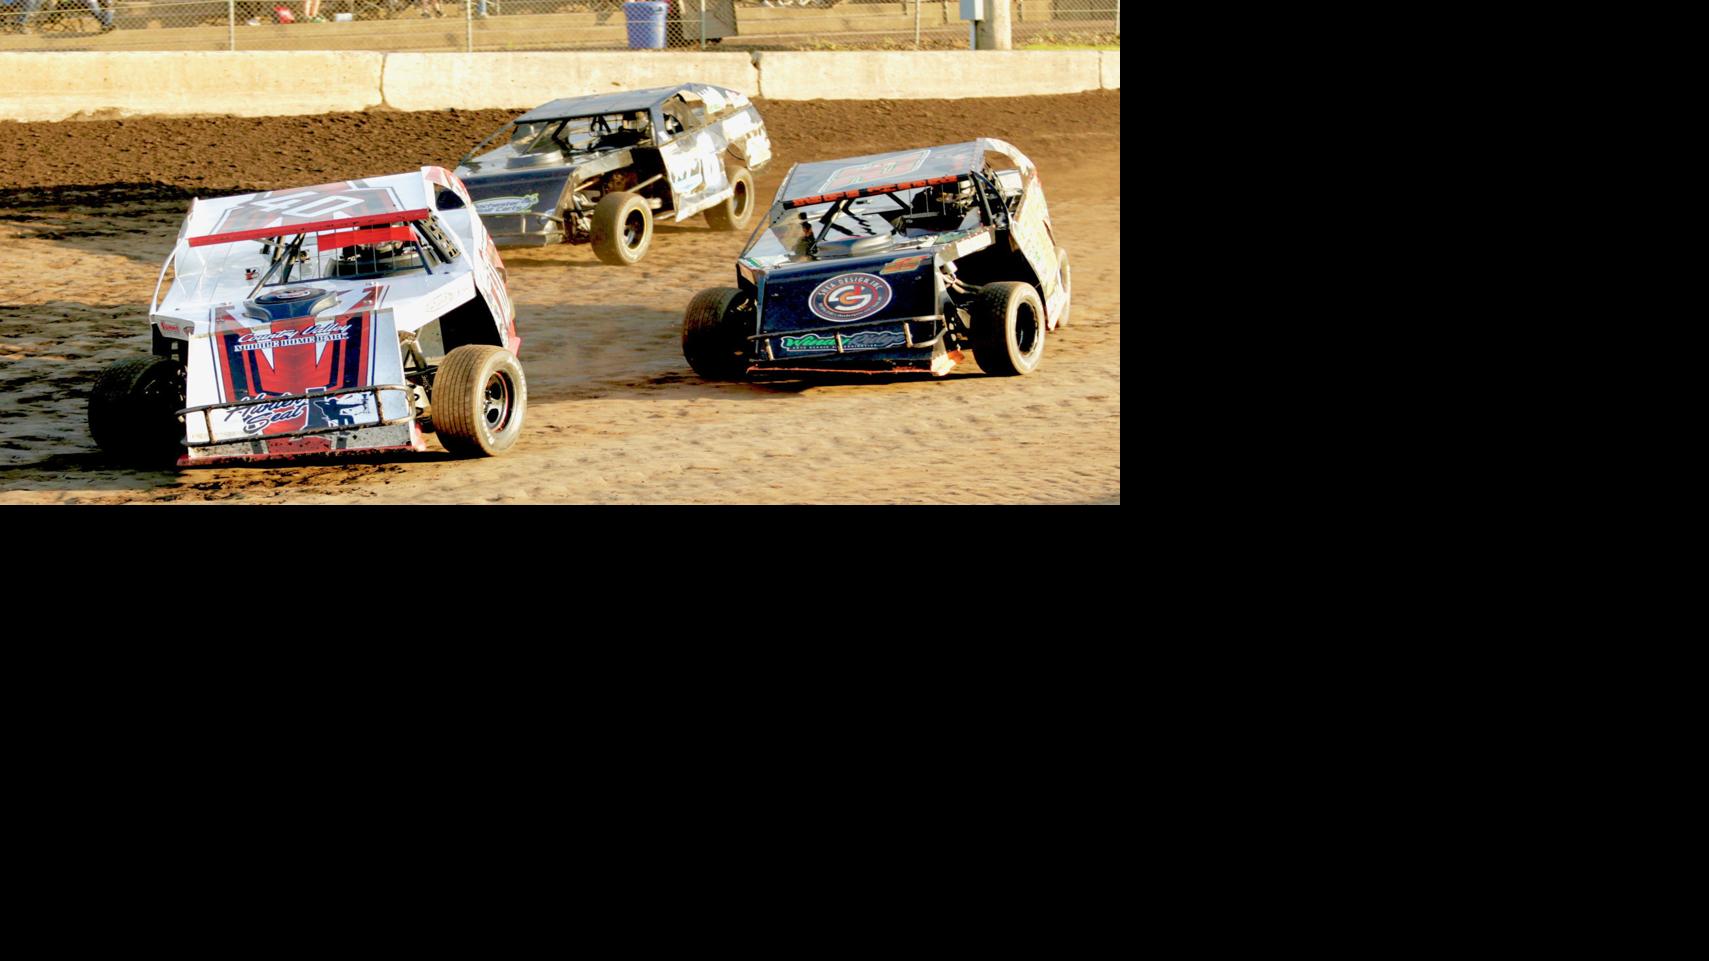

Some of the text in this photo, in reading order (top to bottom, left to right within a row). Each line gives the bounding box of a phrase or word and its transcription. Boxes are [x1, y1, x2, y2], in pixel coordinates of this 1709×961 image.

[839, 276, 870, 286] DESIGN
[238, 321, 353, 342] Country Valley
[281, 335, 315, 346] HOME
